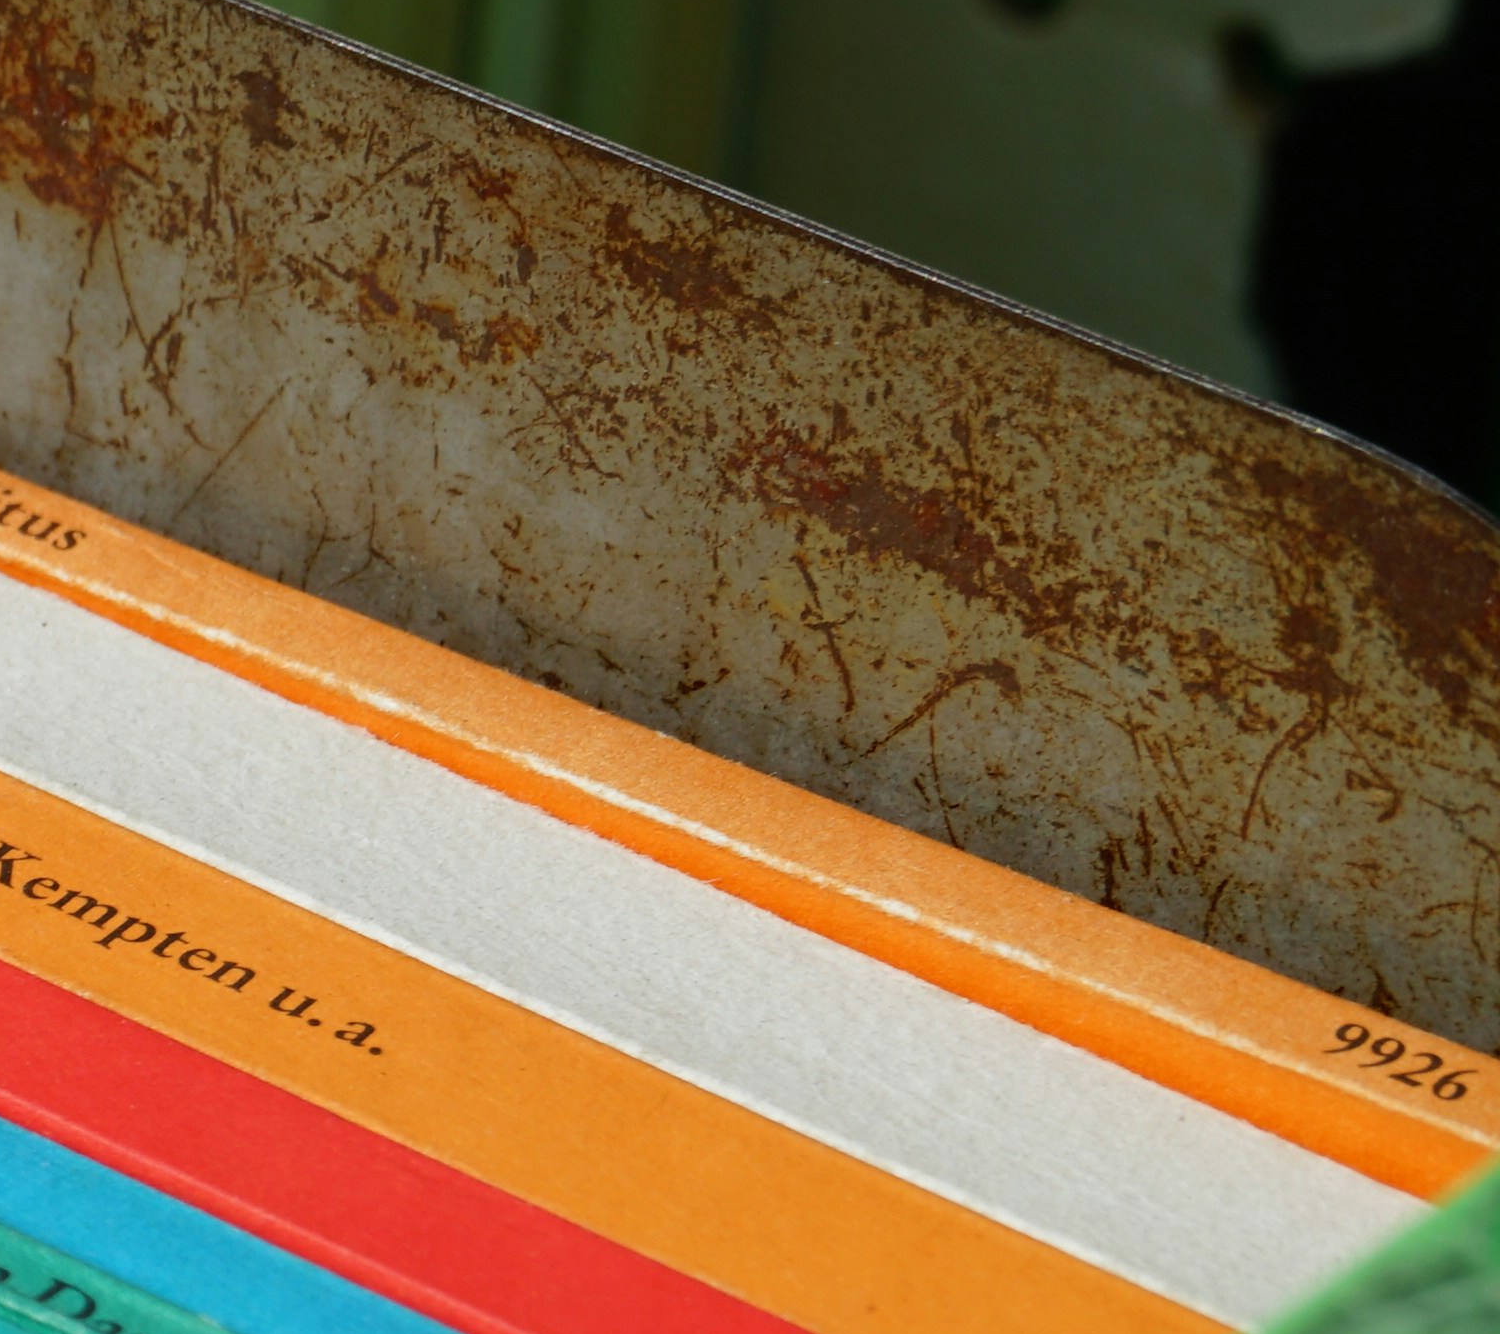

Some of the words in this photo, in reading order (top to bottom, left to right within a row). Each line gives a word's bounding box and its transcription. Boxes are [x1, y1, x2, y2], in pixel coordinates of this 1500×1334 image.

[268, 985, 323, 1027] u.
[334, 1017, 385, 1057] a.
[1322, 1021, 1480, 1102] 9926
